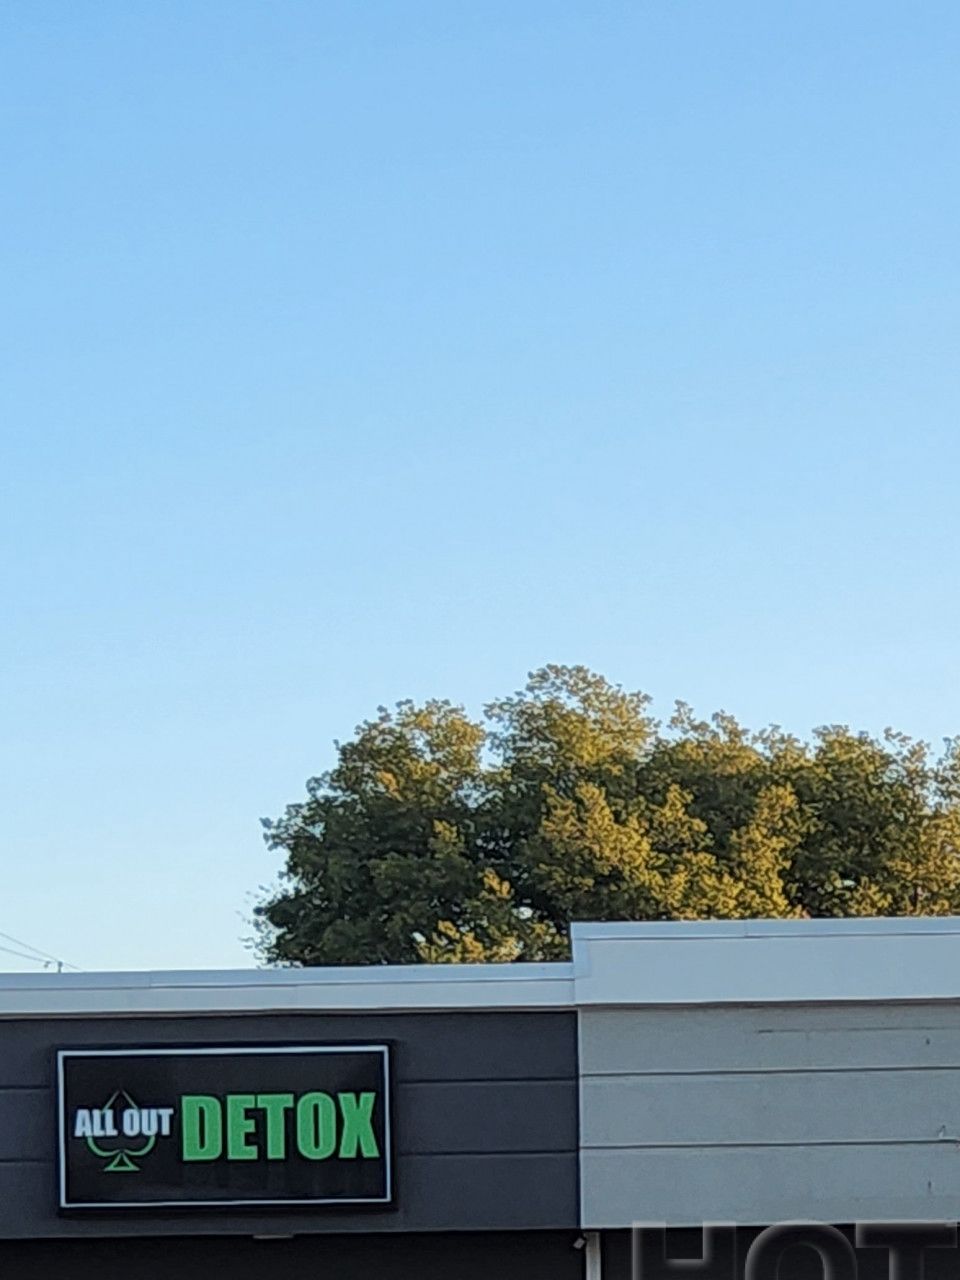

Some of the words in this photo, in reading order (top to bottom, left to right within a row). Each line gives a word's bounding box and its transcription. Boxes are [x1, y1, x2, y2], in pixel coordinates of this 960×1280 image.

[74, 1108, 117, 1137] ALL
[122, 1108, 174, 1136] OUT
[181, 1092, 380, 1161] DETOX
